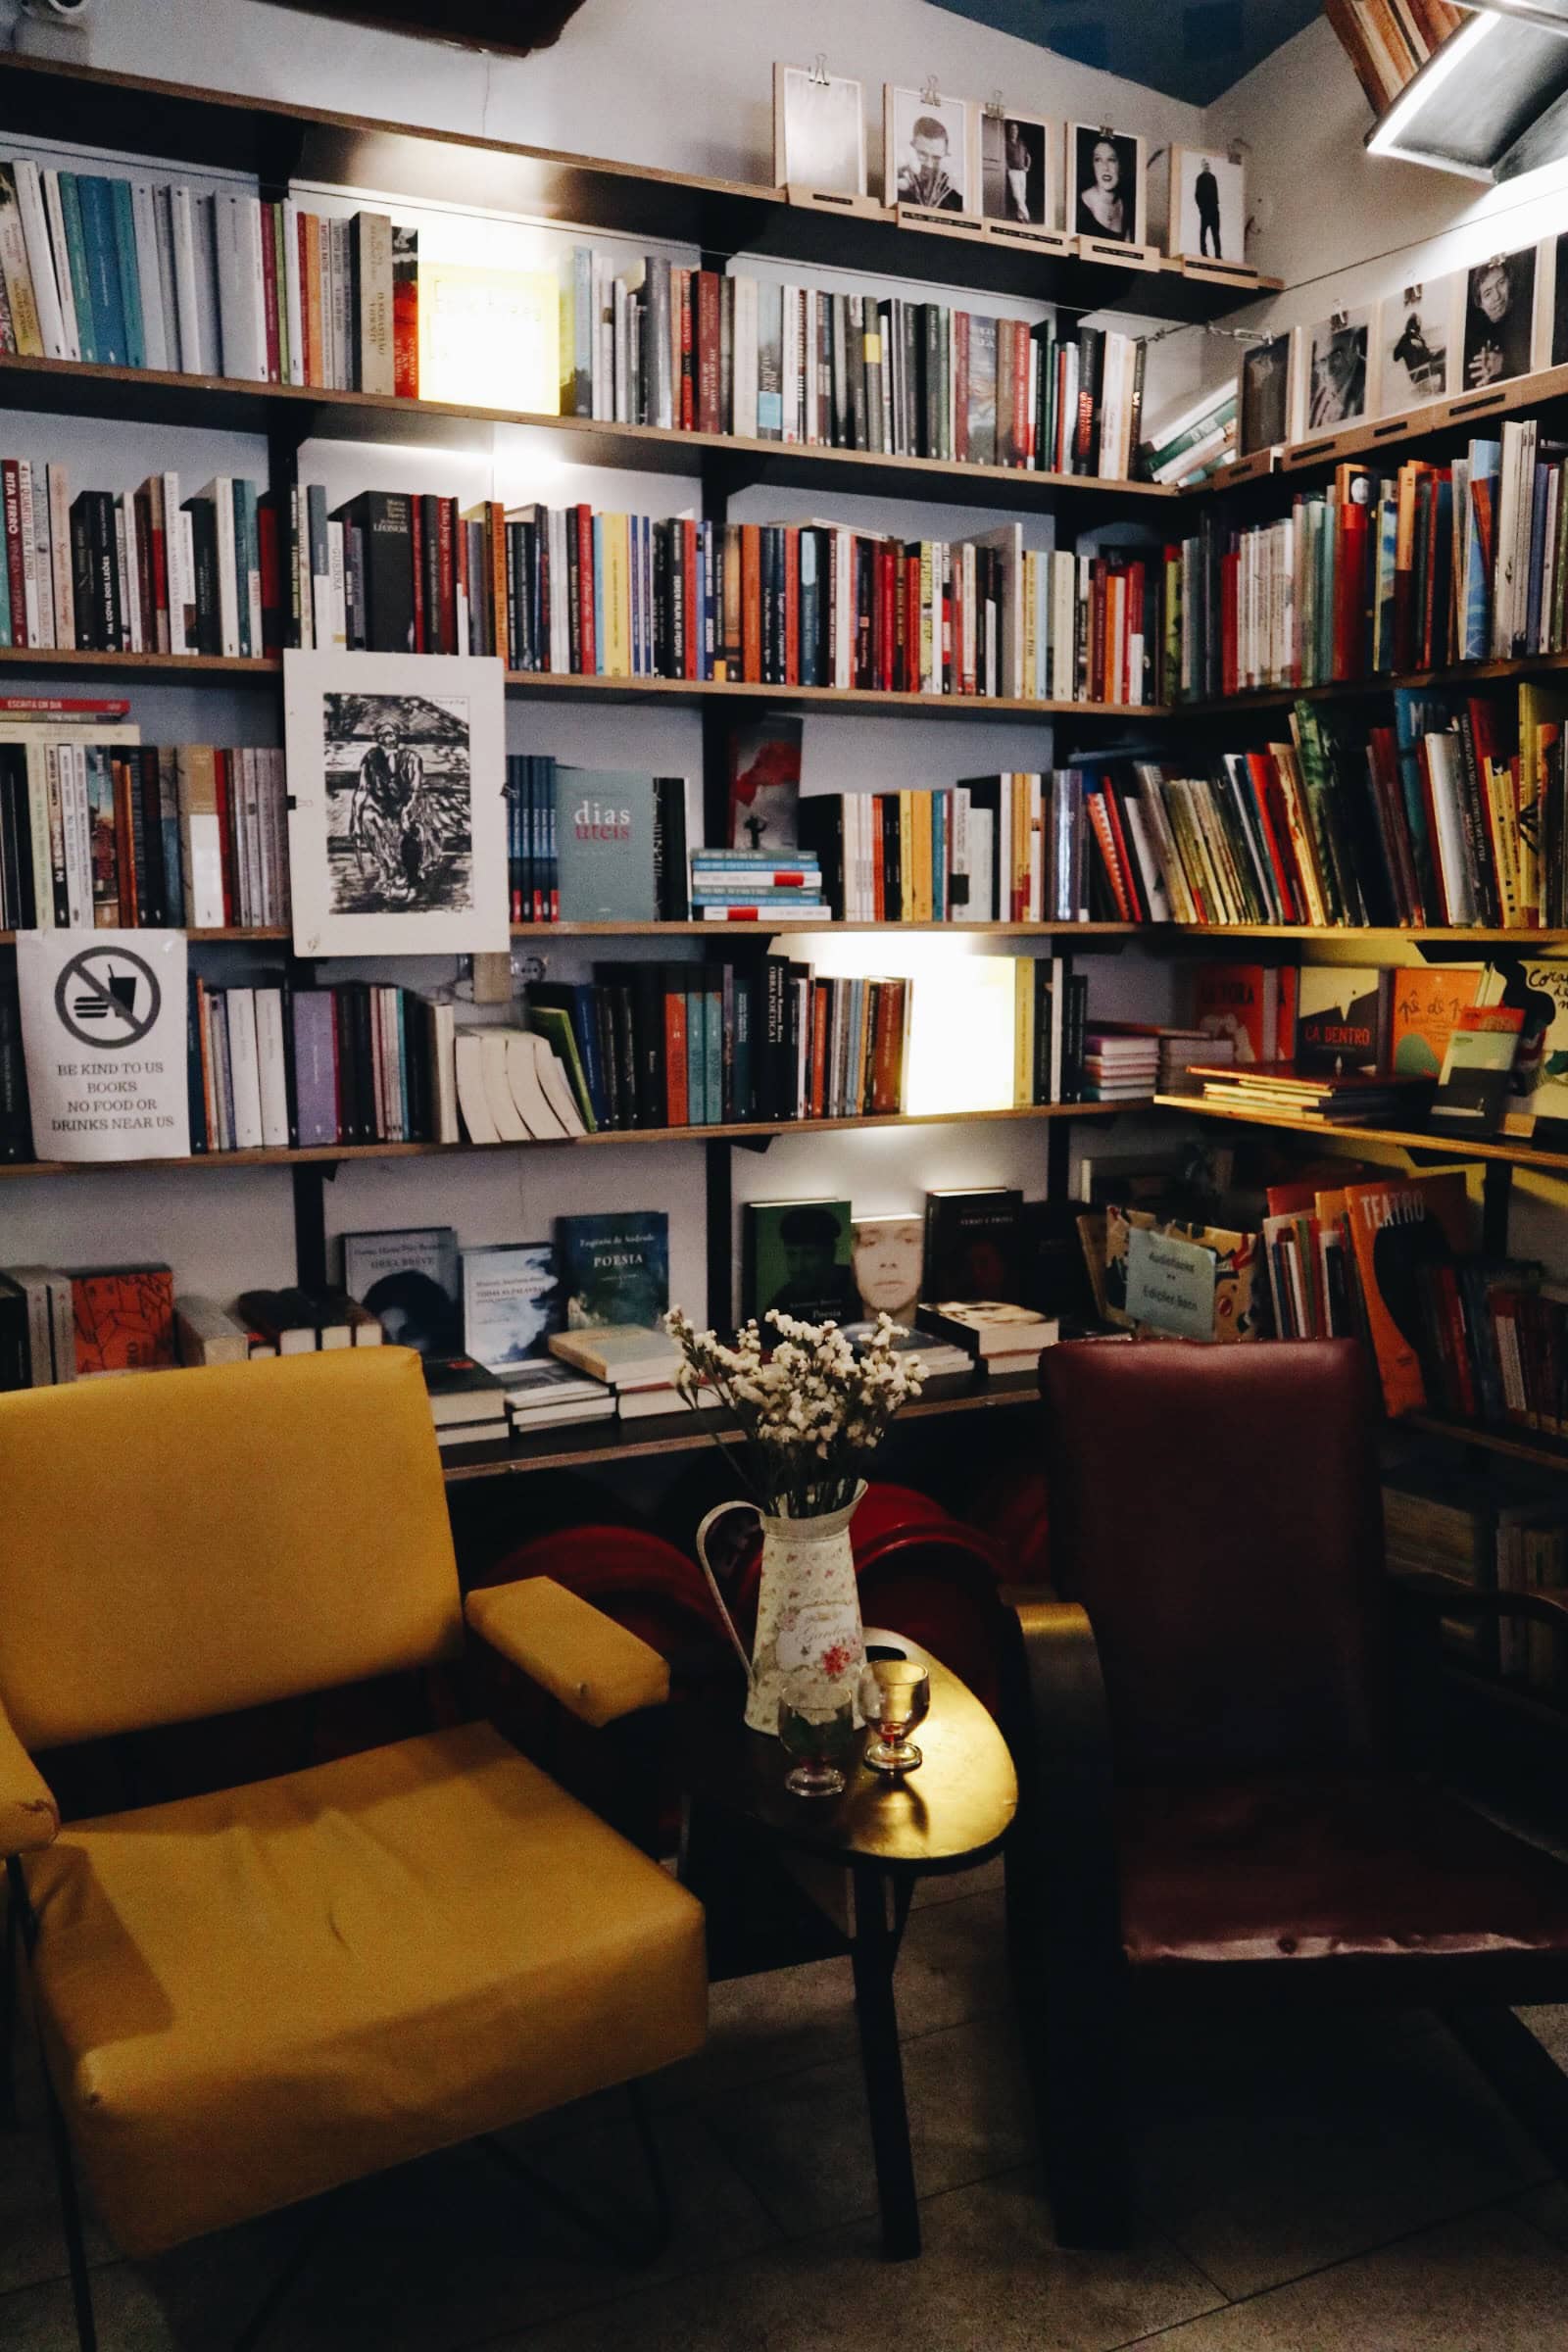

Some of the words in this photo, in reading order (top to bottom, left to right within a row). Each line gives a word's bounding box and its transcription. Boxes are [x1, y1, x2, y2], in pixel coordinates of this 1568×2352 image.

[6, 472, 17, 495] RITA
[8, 499, 18, 534] FERRO
[573, 800, 631, 825] dias
[768, 966, 777, 993] OBRA
[768, 996, 778, 1038] POÉTICA
[1324, 1027, 1372, 1047] DENTRO
[57, 1064, 78, 1077] BE
[80, 1063, 119, 1076] KIND
[122, 1062, 142, 1075] TO
[145, 1061, 165, 1074] US
[87, 1081, 138, 1094] BOOKS
[68, 1102, 90, 1113] NO
[94, 1100, 134, 1112] FOOD
[137, 1099, 158, 1110] OR
[51, 1119, 109, 1133] DRINKS
[112, 1117, 154, 1131] NEAR
[157, 1116, 175, 1129] US
[1360, 1190, 1427, 1230] TEATRO
[593, 1253, 644, 1268] POESIA
